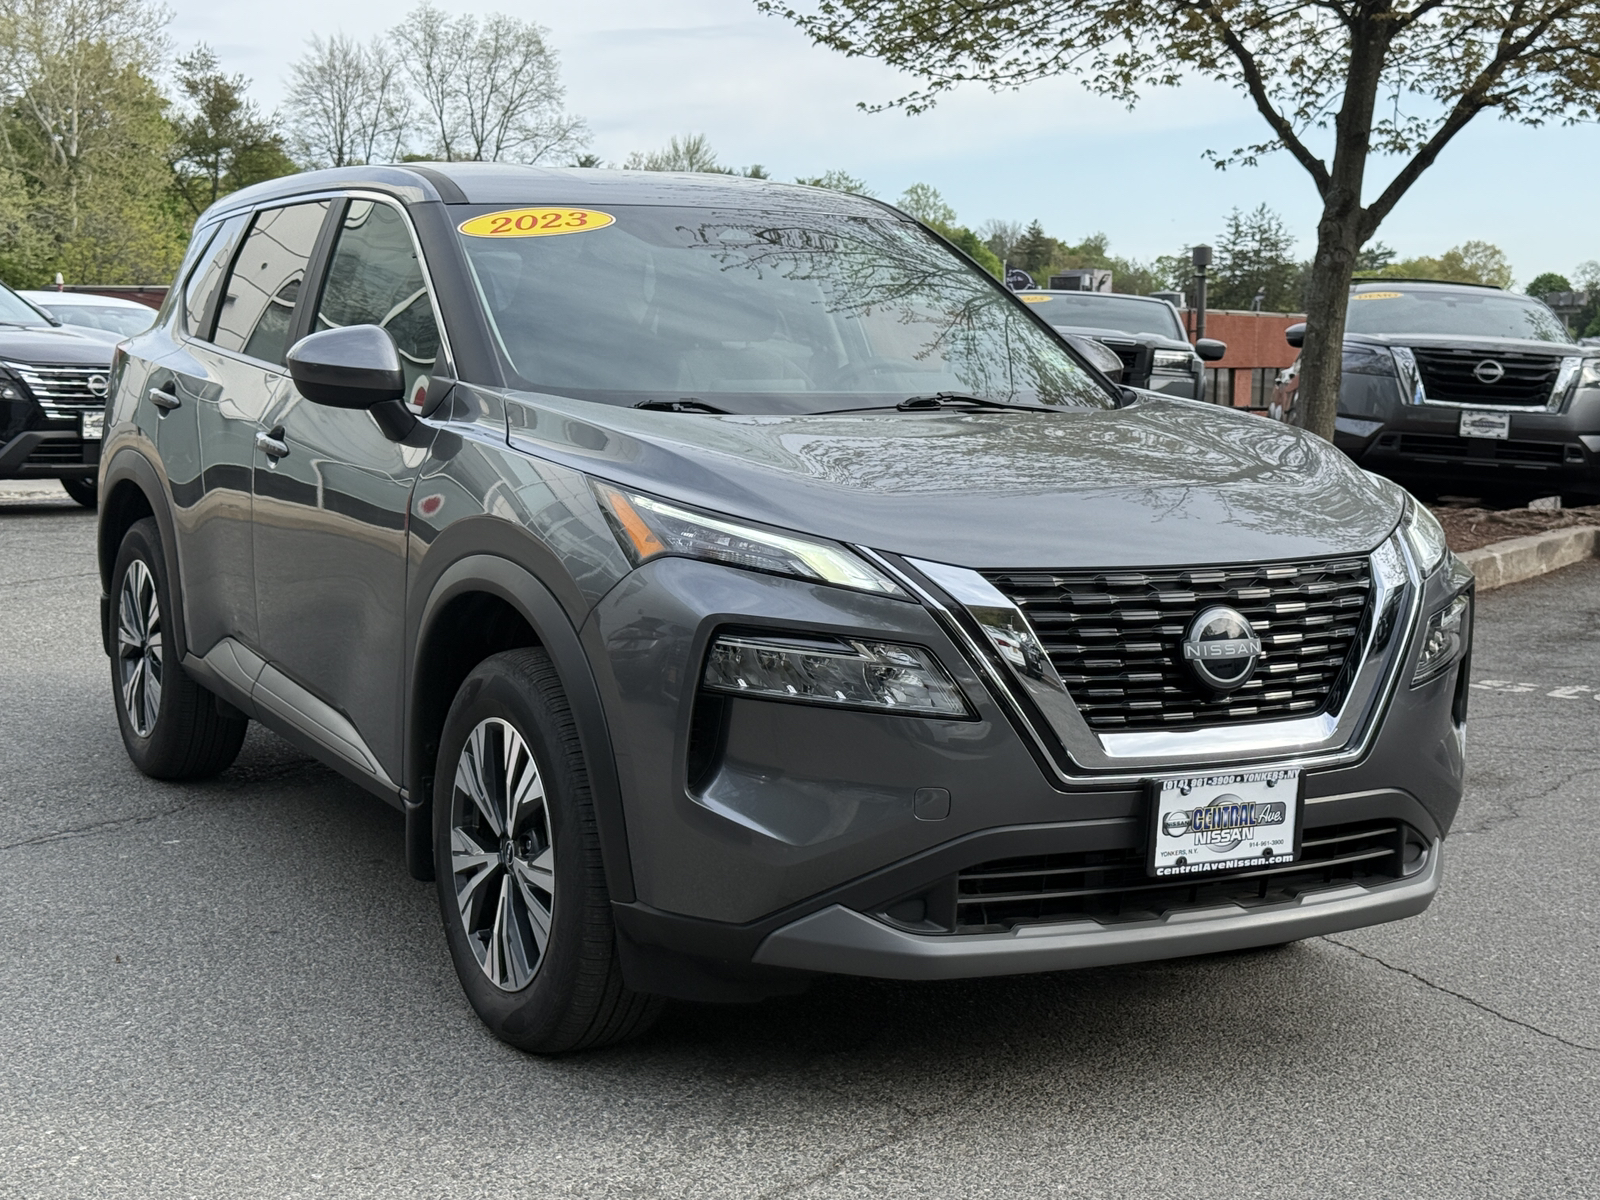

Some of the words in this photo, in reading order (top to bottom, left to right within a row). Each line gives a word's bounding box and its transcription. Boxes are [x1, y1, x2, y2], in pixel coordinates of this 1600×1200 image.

[490, 212, 588, 234] 2023
[1186, 641, 1260, 657] NISSAN
[1191, 801, 1257, 832] CENTRAL
[1257, 804, 1283, 823] Ave.
[1194, 827, 1254, 846] NISSAN
[1249, 839, 1284, 848] 914-961-3900
